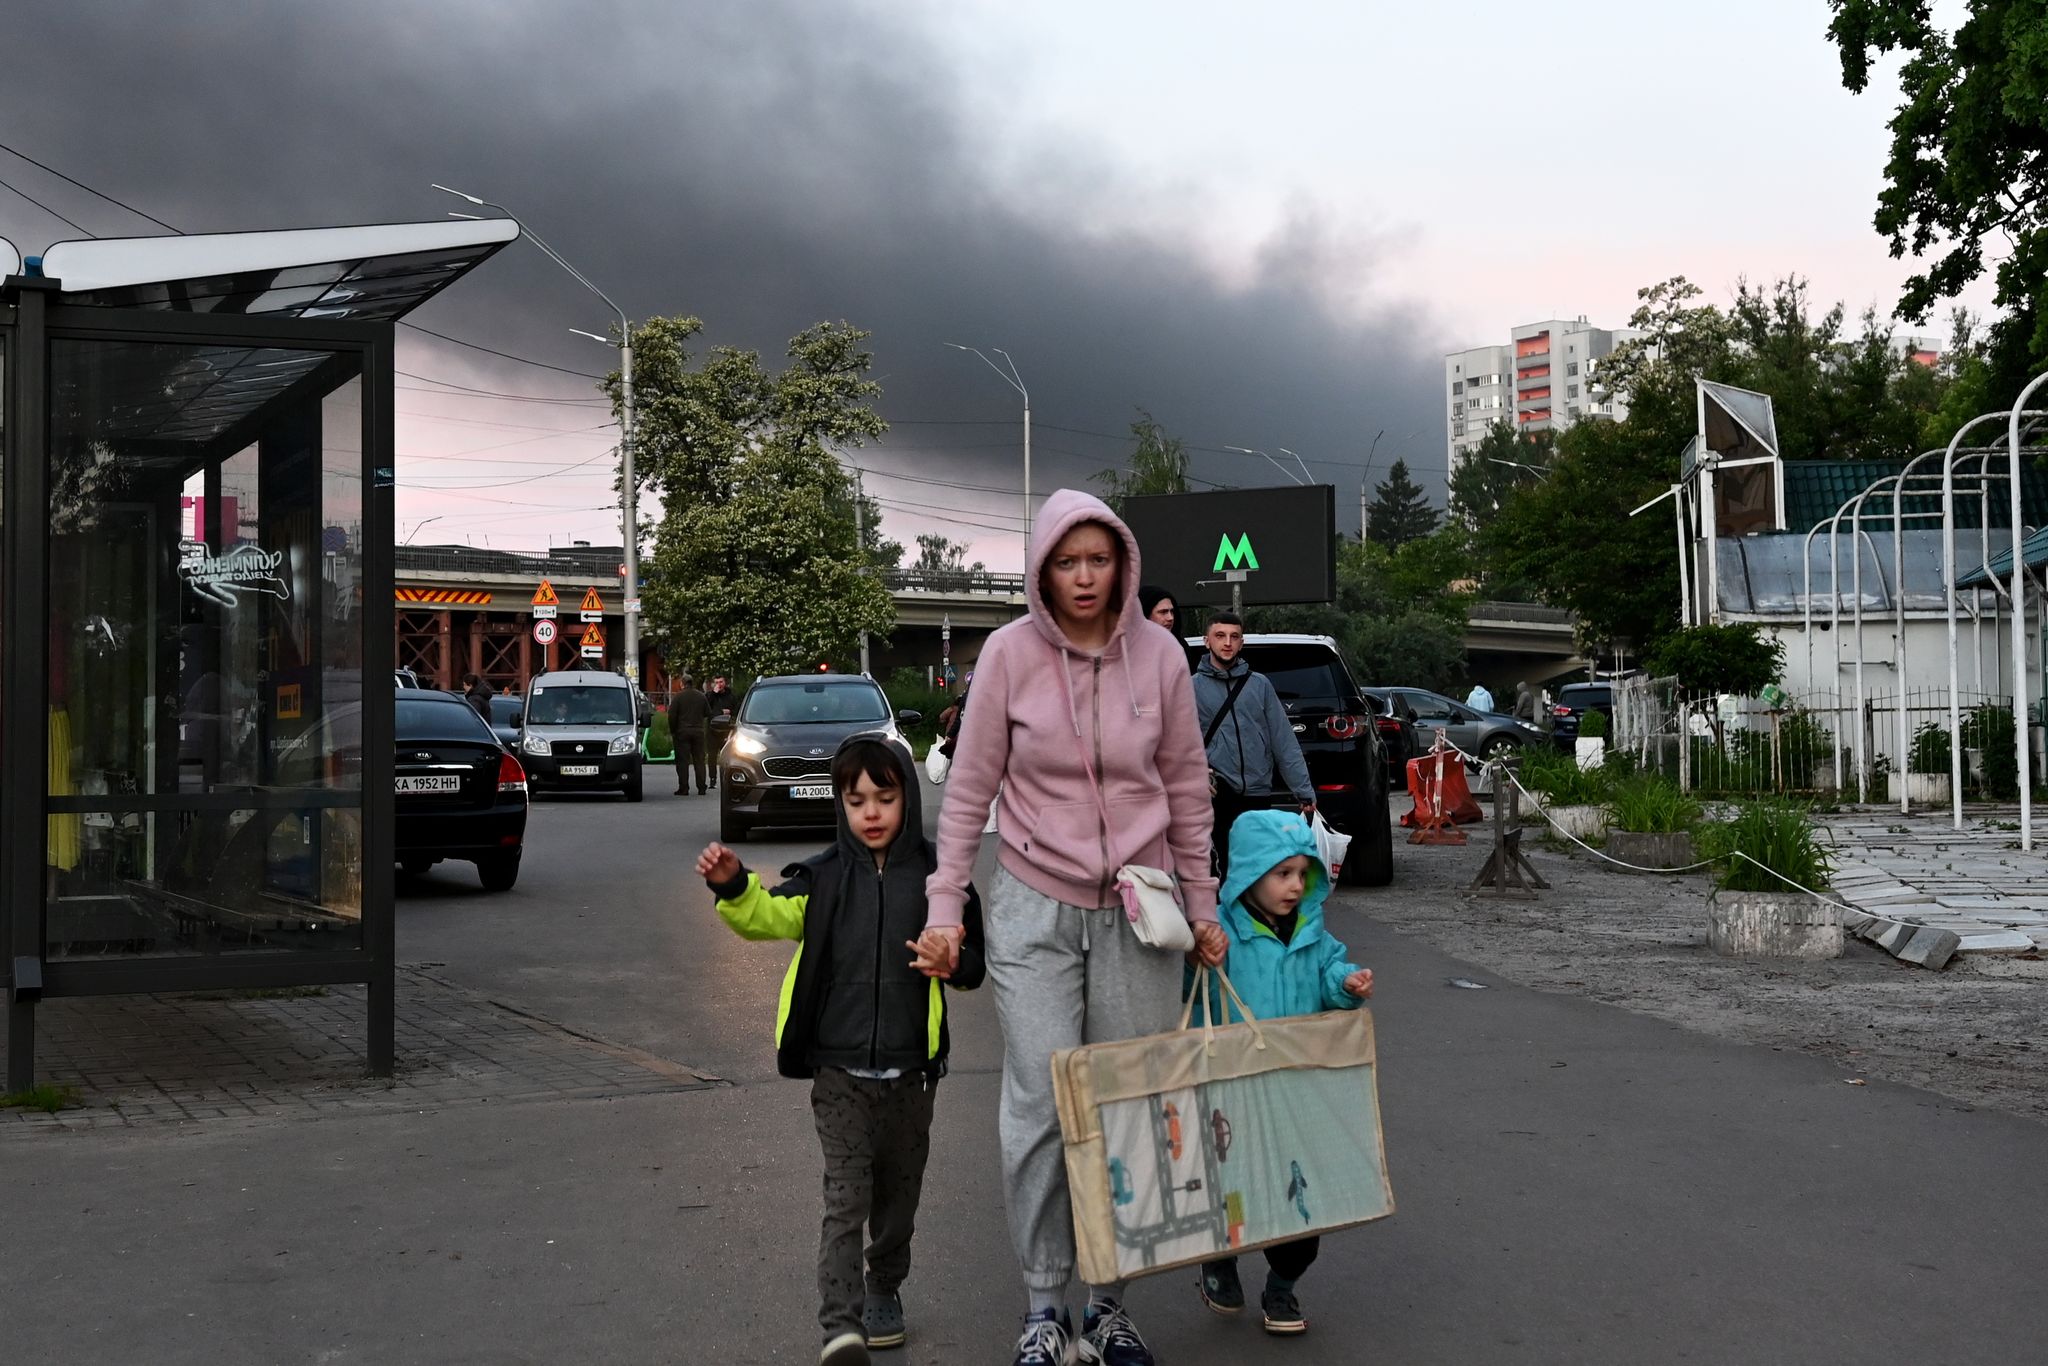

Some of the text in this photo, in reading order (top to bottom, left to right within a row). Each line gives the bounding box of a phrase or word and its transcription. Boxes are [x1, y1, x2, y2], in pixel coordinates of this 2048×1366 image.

[538, 627, 552, 637] 40
[413, 778, 438, 790] 1952
[441, 777, 457, 789] HH
[796, 787, 830, 796] AA 2005
